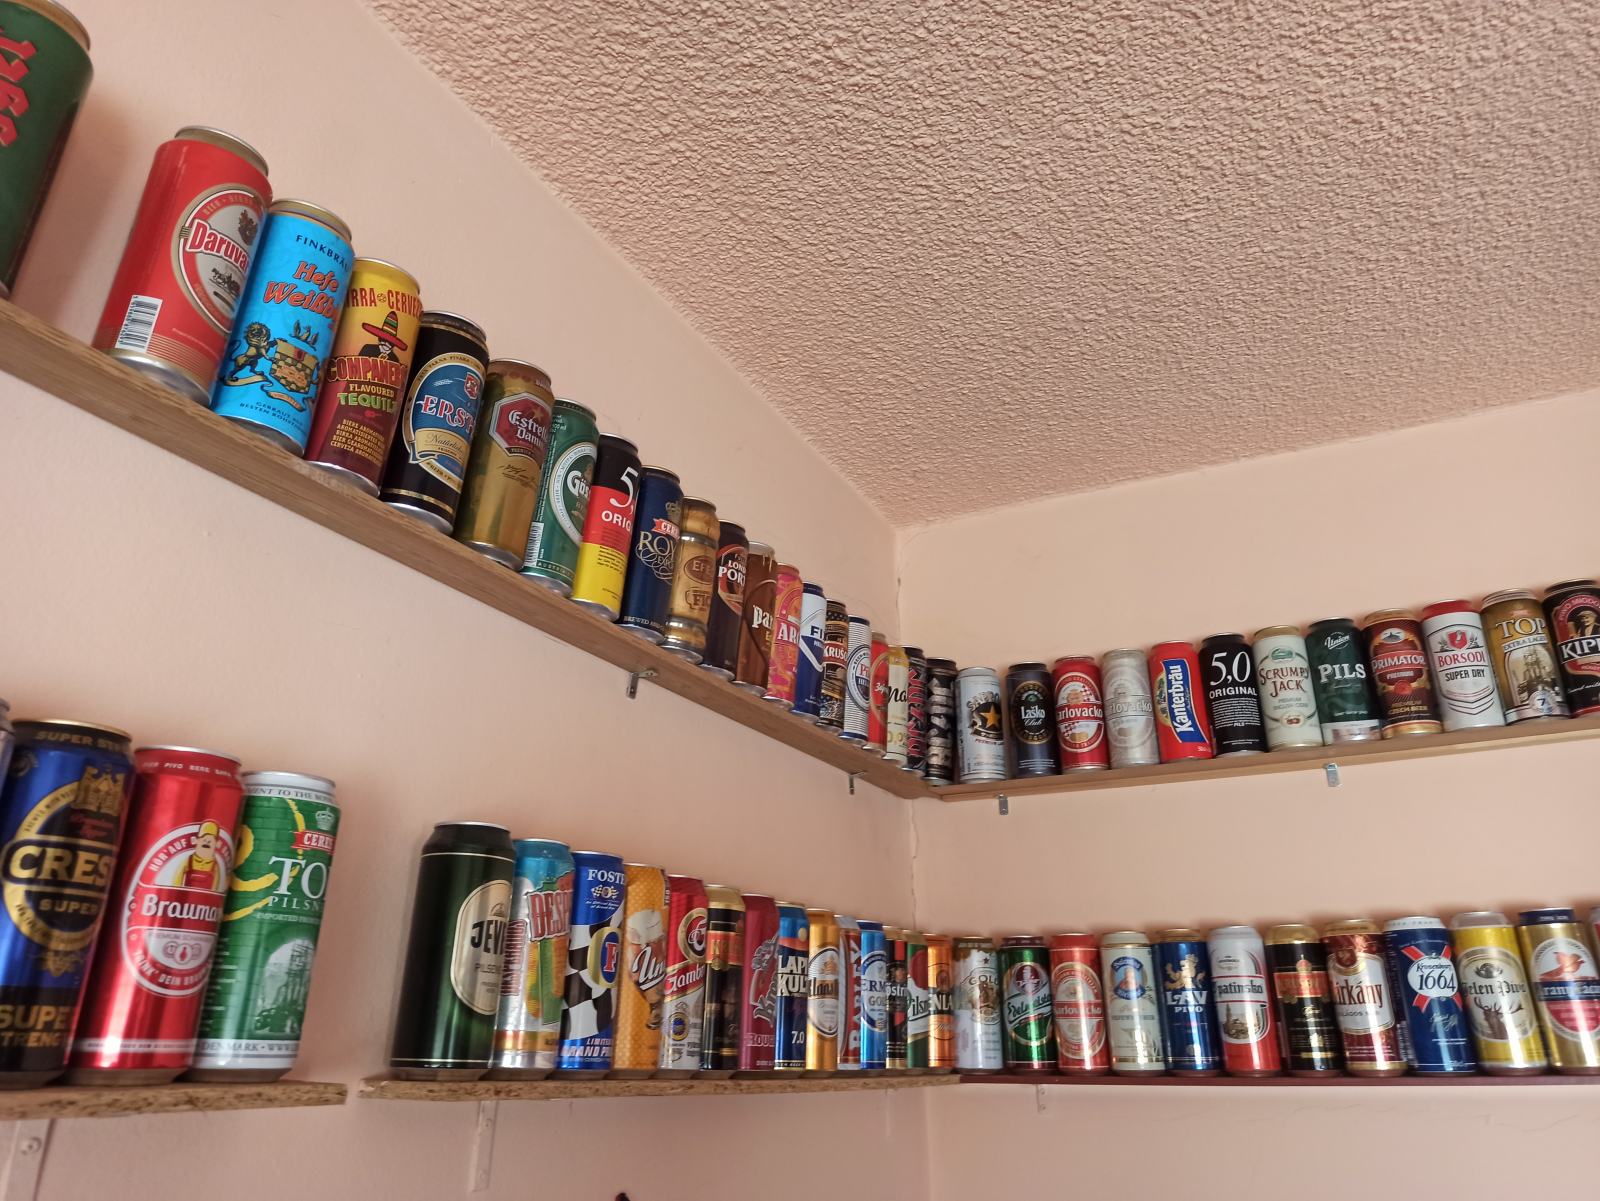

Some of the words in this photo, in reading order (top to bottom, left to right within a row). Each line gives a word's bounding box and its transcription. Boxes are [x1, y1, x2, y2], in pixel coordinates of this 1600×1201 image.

[293, 260, 339, 292] Hefe
[349, 384, 394, 397] FLAVOURED
[1210, 651, 1251, 686] 5,0
[1438, 653, 1486, 672] BORSODI
[1259, 667, 1309, 685] SCRUMPY
[1319, 663, 1367, 682] PILS
[1445, 671, 1469, 685] SUPER
[1472, 670, 1486, 683] DRY
[1208, 686, 1258, 699] ORIGINAL
[1270, 679, 1306, 697] JACK
[1021, 705, 1045, 719] Laško
[37, 731, 93, 746] SUPER
[269, 856, 327, 899] TO
[1418, 970, 1456, 992] 1664
